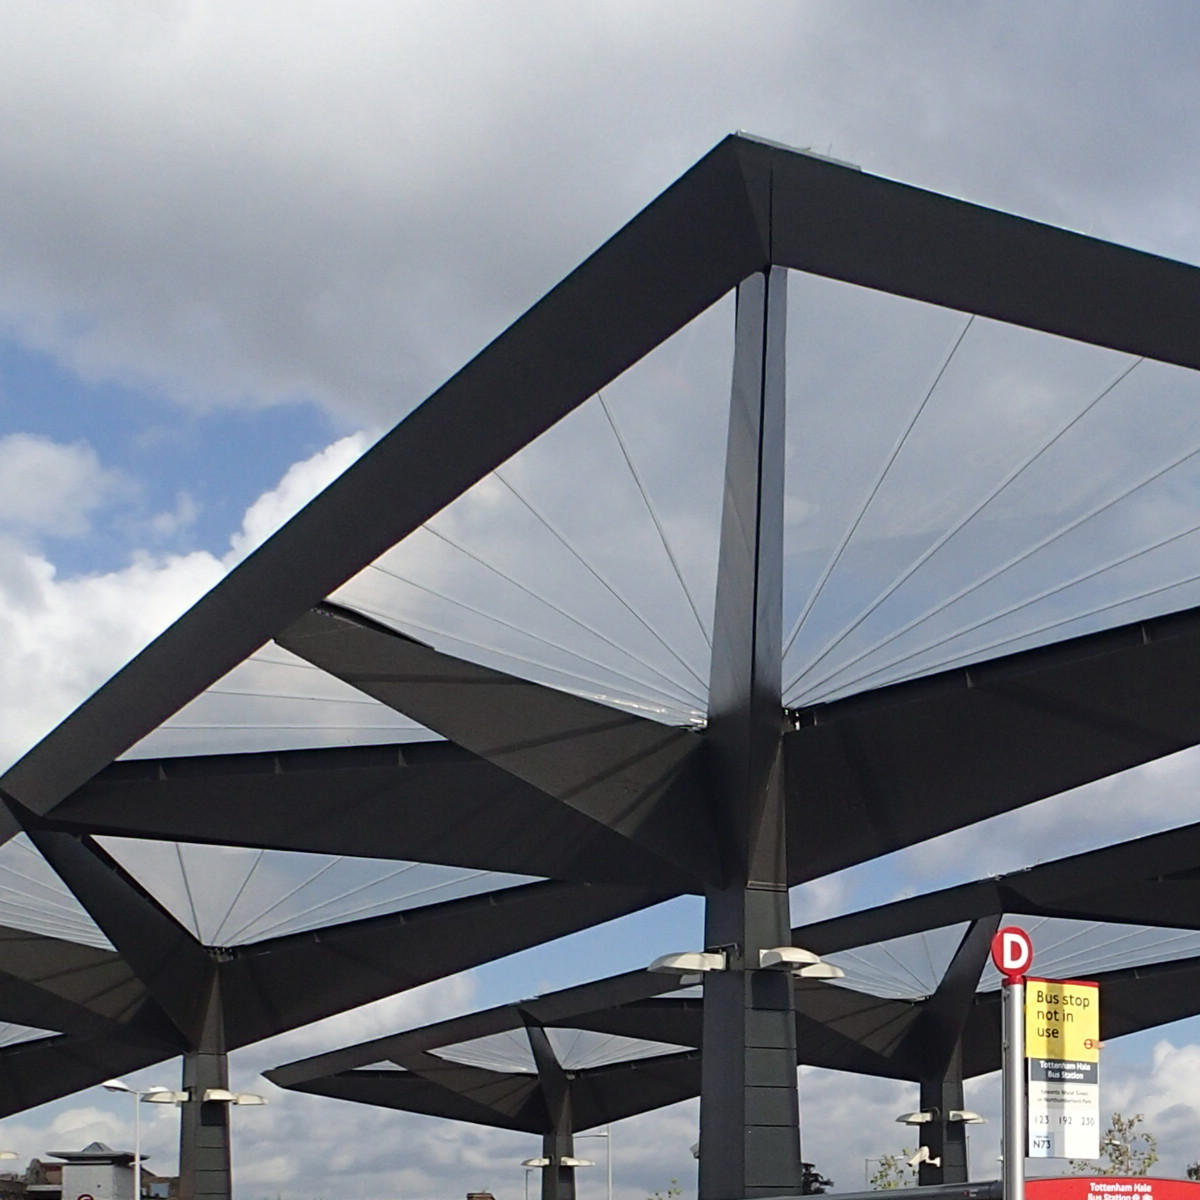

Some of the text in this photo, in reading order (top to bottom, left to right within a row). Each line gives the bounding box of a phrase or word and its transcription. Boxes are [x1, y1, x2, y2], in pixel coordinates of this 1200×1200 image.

[1003, 933, 1029, 969] D
[1036, 990, 1091, 1011] Bus stop
[1036, 1008, 1075, 1023] not in
[1036, 1026, 1060, 1039] use
[1039, 1060, 1076, 1070] Tottenham
[1047, 1070, 1084, 1080] Bus Station
[1034, 1115, 1050, 1125] 123
[1058, 1115, 1073, 1125] 192
[1033, 1139, 1051, 1150] N73
[1090, 1182, 1152, 1193] Tottenham Hale
